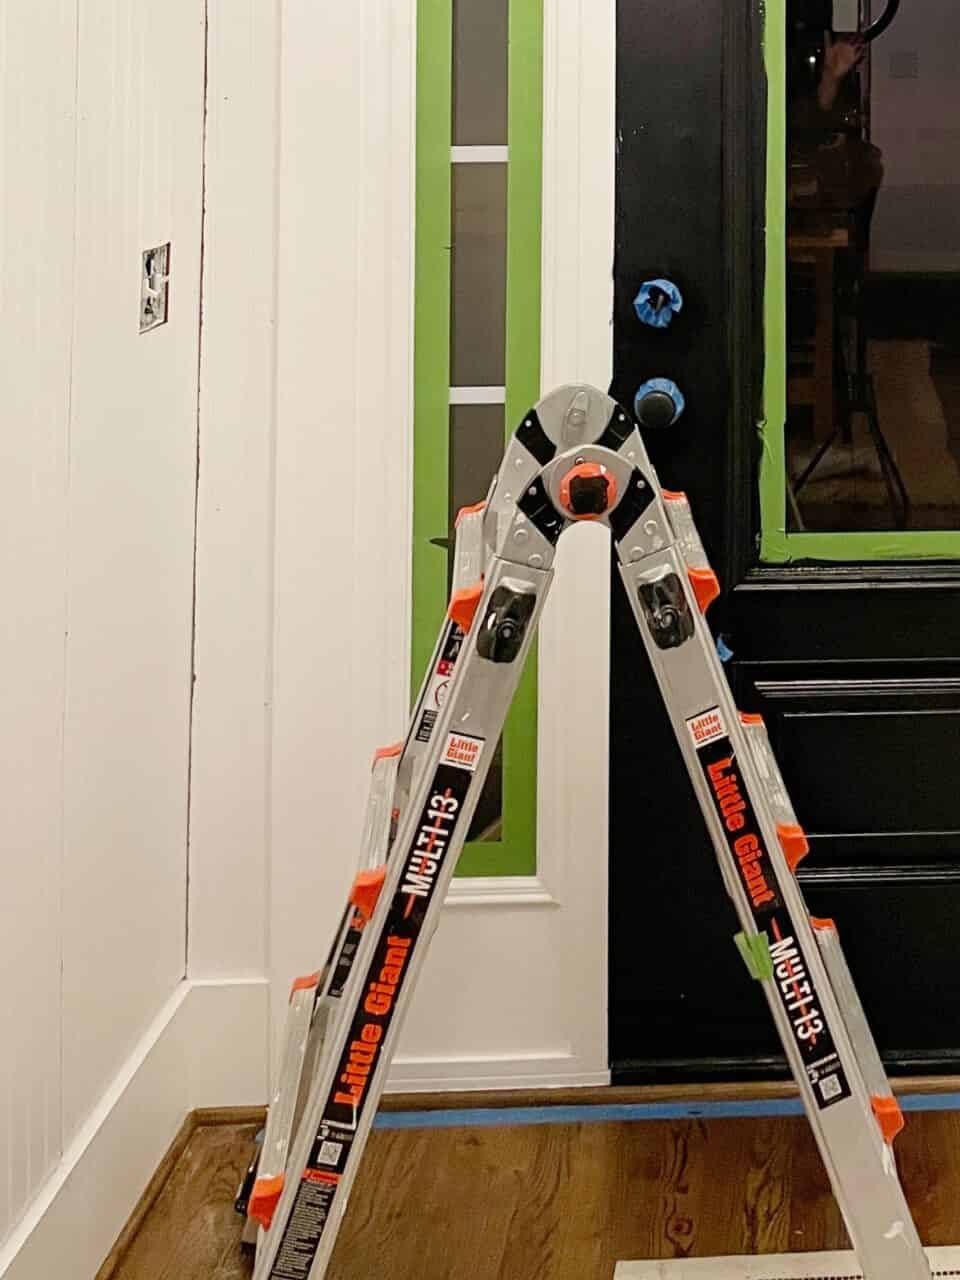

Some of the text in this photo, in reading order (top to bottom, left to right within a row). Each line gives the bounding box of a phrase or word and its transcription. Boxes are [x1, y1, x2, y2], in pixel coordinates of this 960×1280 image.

[707, 757, 746, 832] Little
[734, 833, 775, 908] Giant
[333, 1024, 382, 1106] Little
[364, 935, 412, 1015] Giant
